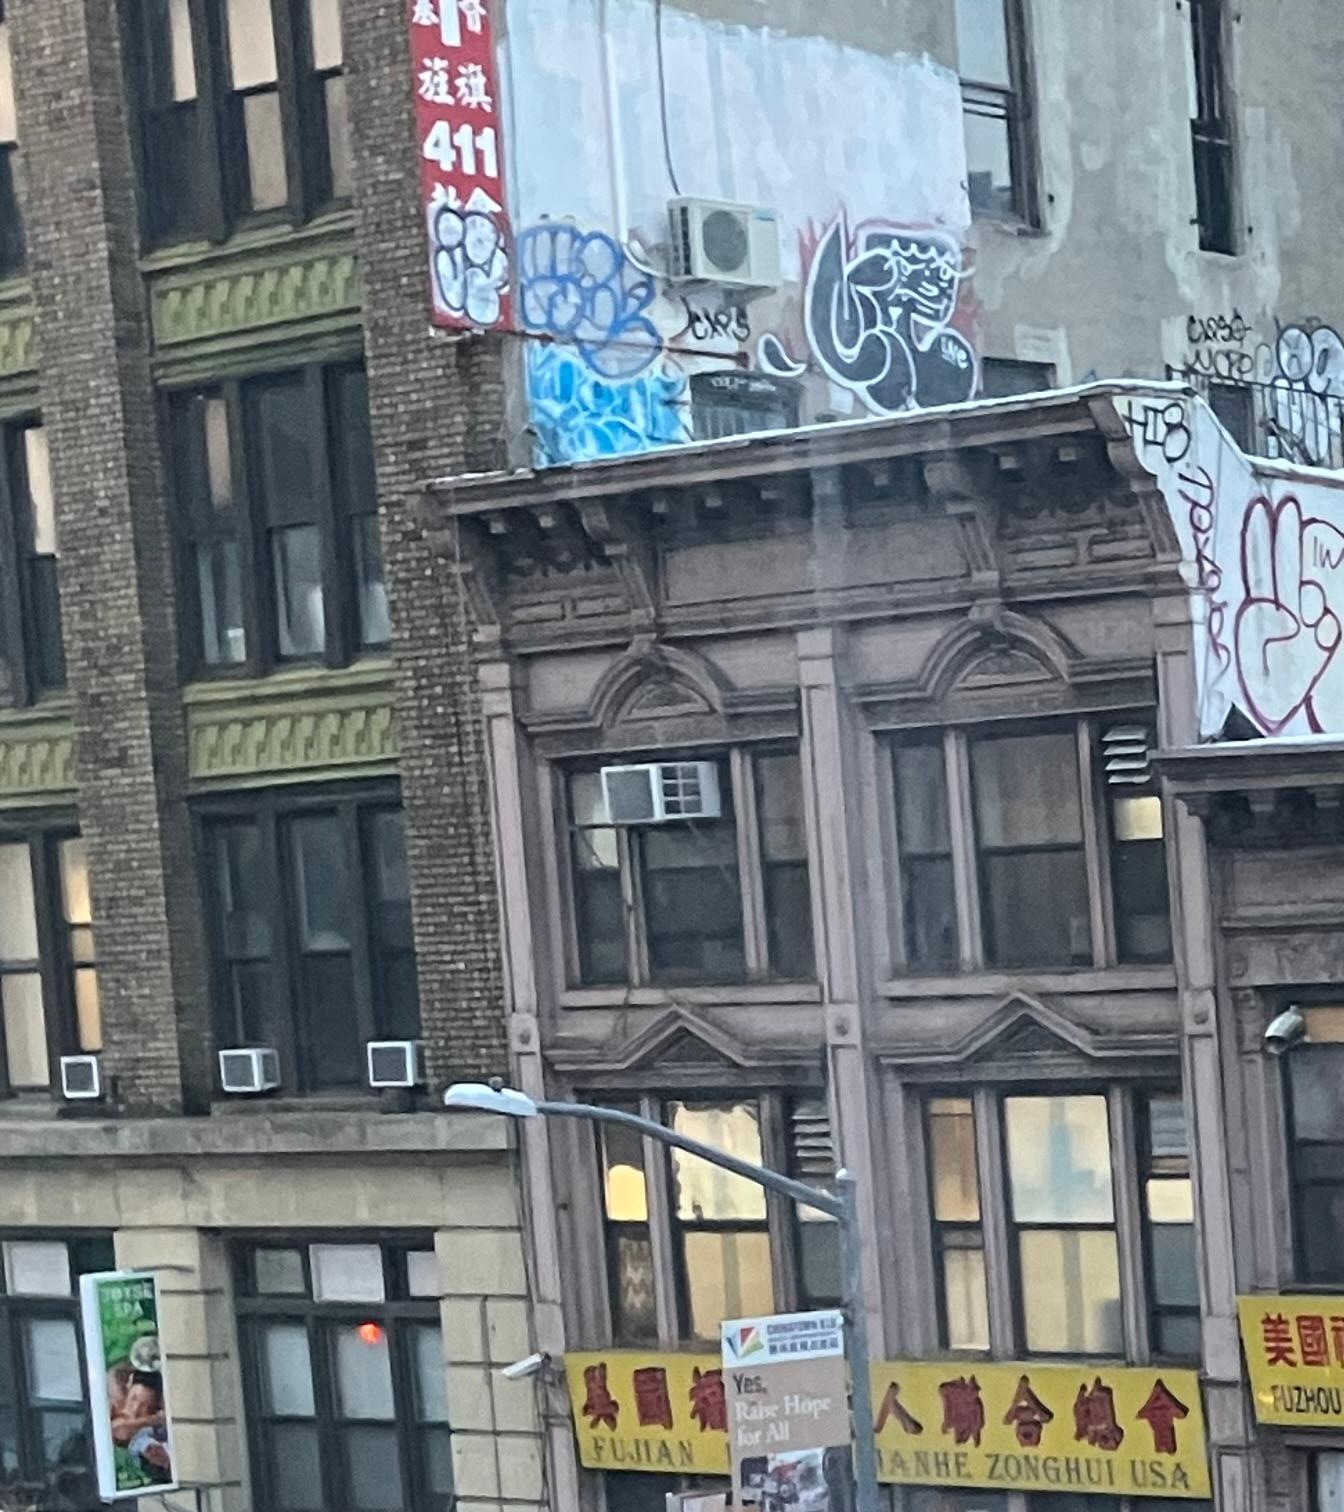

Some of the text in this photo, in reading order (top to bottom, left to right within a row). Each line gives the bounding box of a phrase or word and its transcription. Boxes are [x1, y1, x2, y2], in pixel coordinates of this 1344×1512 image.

[423, 119, 499, 178] 411
[783, 1395, 831, 1420] Hope
[1271, 1384, 1342, 1415] FUZHOU
[737, 1420, 791, 1447] for All
[591, 1436, 694, 1468] FUJIAN
[985, 1453, 1116, 1488] ZONGHUI
[1130, 1460, 1191, 1491] USA
